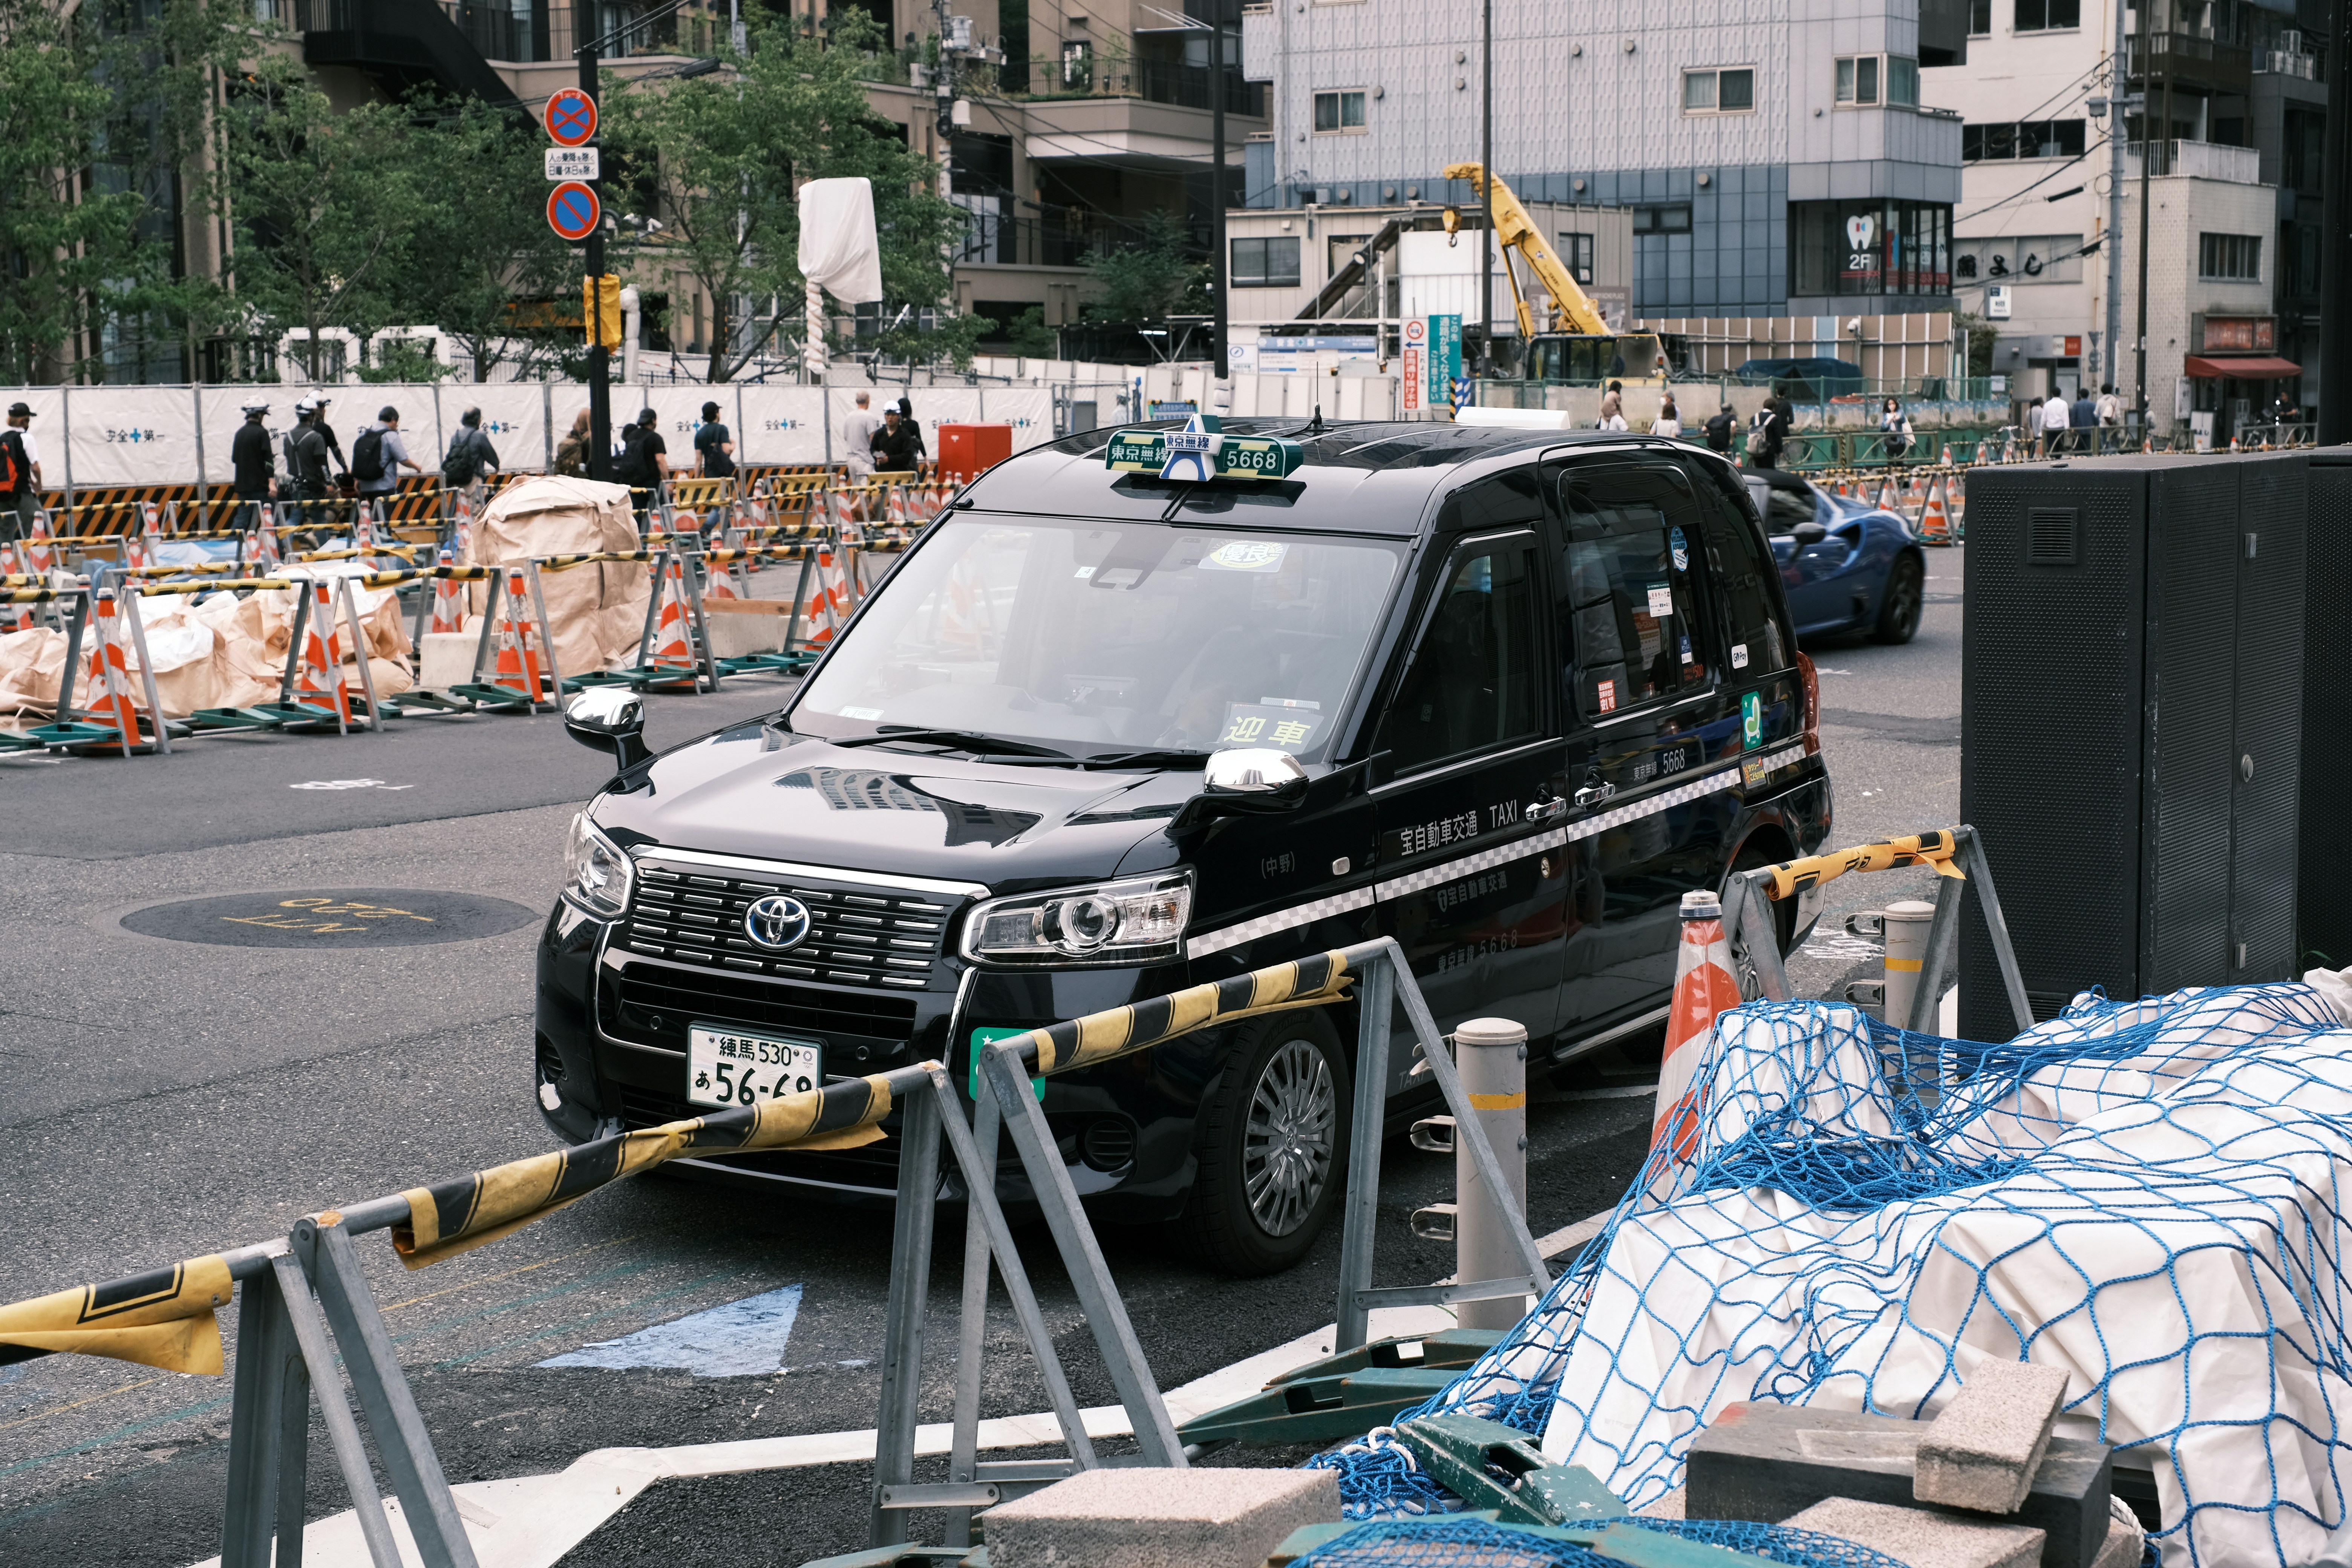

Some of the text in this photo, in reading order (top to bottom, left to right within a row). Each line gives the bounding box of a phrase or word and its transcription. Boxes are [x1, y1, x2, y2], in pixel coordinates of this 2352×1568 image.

[1850, 254, 1870, 269] 2F
[502, 422, 519, 434] 第一
[677, 421, 691, 432] 安全
[766, 420, 805, 431] 安全 第一
[144, 429, 165, 442] 第一
[1166, 435, 1209, 449] 東京無線
[1111, 445, 1168, 463] 東京無線
[1226, 451, 1277, 469] 5668
[1220, 544, 1270, 563] 優良
[1223, 716, 1311, 745] 迎車
[1634, 748, 1685, 781] 東京無線 5668
[1748, 763, 1759, 772] タクシー
[1401, 799, 1517, 856] 宝自動車交通 TAXI
[1262, 851, 1295, 879] (中野)
[1447, 870, 1507, 906] 宝自動車交通
[1438, 929, 1517, 975] 東京無線 5668
[719, 1036, 792, 1066] 練馬 530
[695, 1070, 710, 1090] あ
